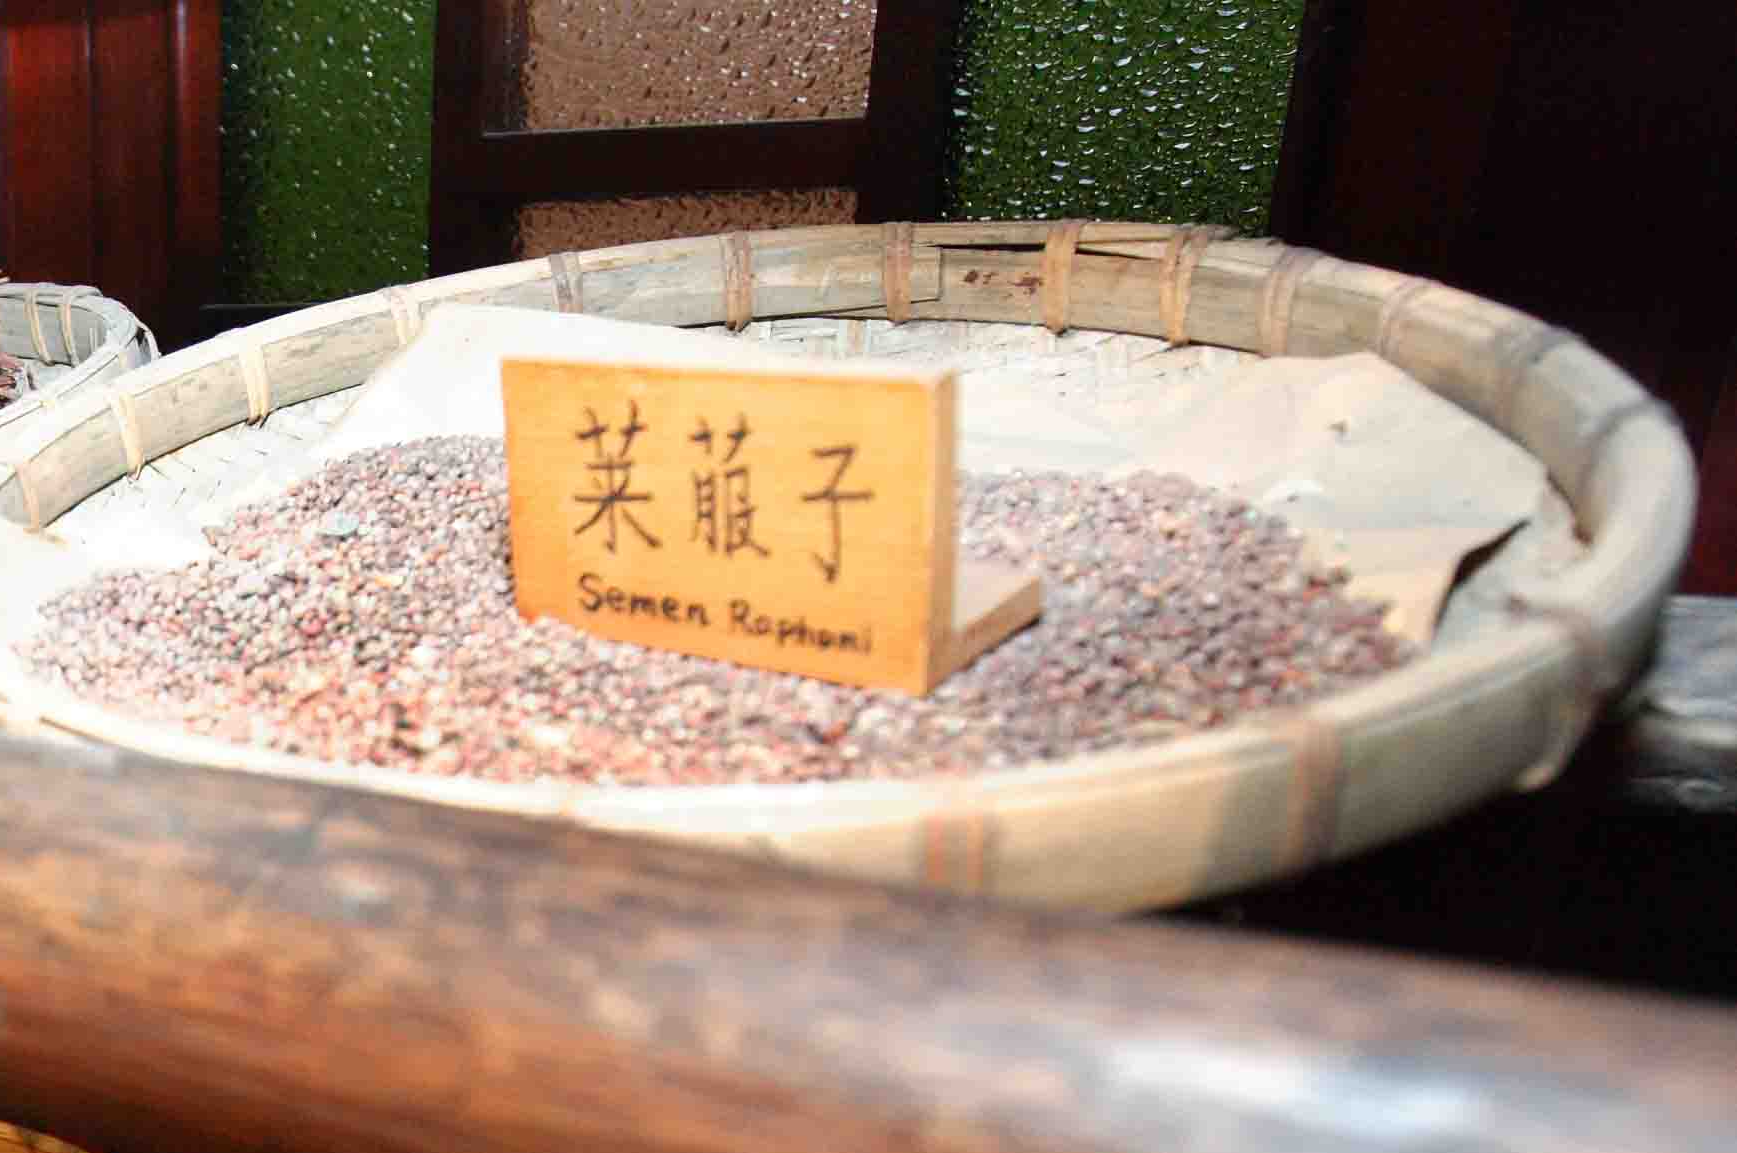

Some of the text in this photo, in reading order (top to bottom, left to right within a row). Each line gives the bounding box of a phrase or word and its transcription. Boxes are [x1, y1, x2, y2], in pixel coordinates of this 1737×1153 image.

[573, 400, 875, 583] 莱菔子
[578, 571, 710, 628] Semen
